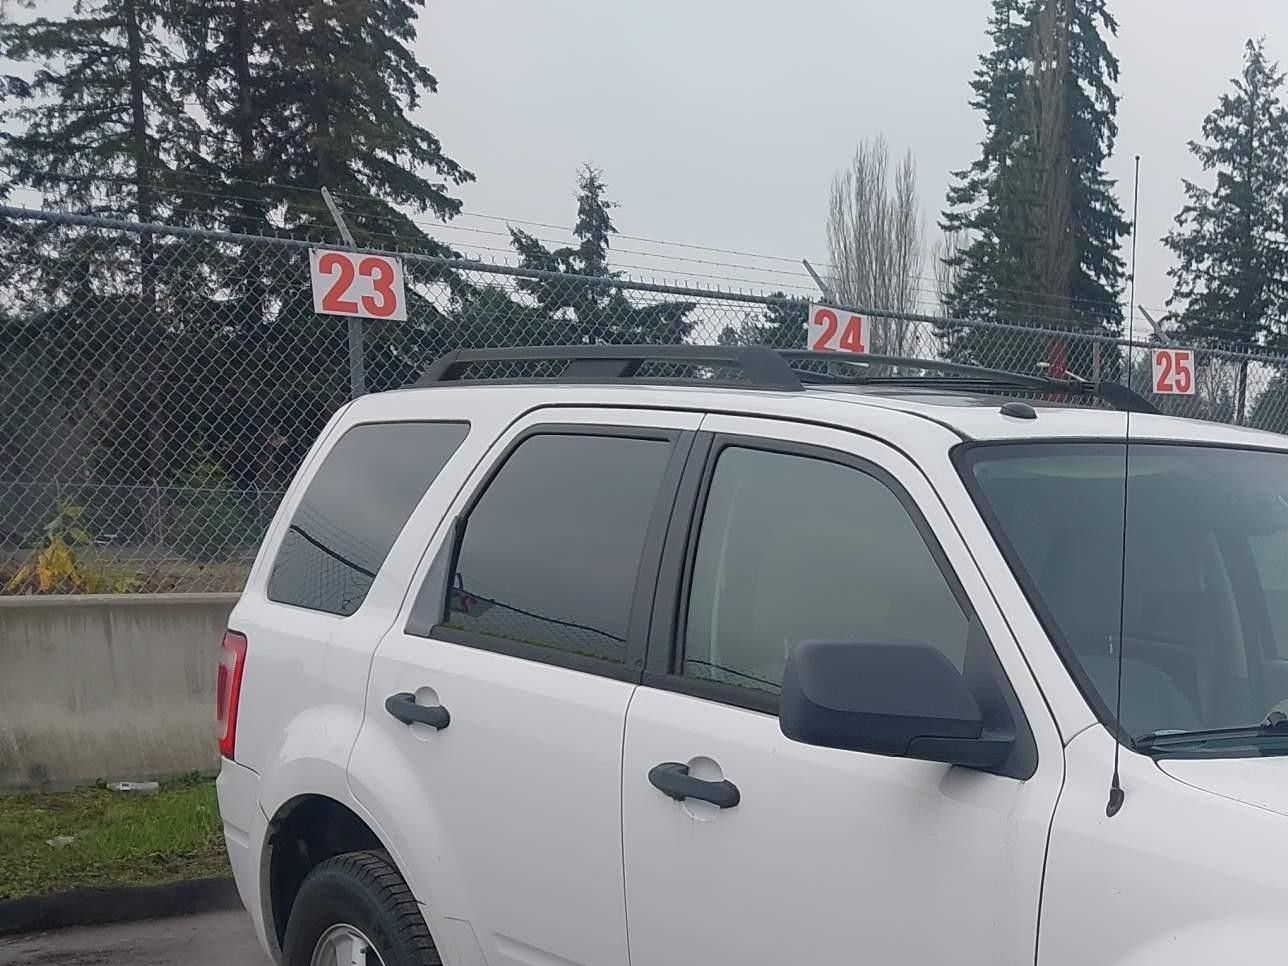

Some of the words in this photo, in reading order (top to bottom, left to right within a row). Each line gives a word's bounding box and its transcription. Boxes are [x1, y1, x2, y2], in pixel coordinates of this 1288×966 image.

[318, 252, 397, 318] 23
[812, 308, 865, 353] 24
[1155, 350, 1191, 393] 25
